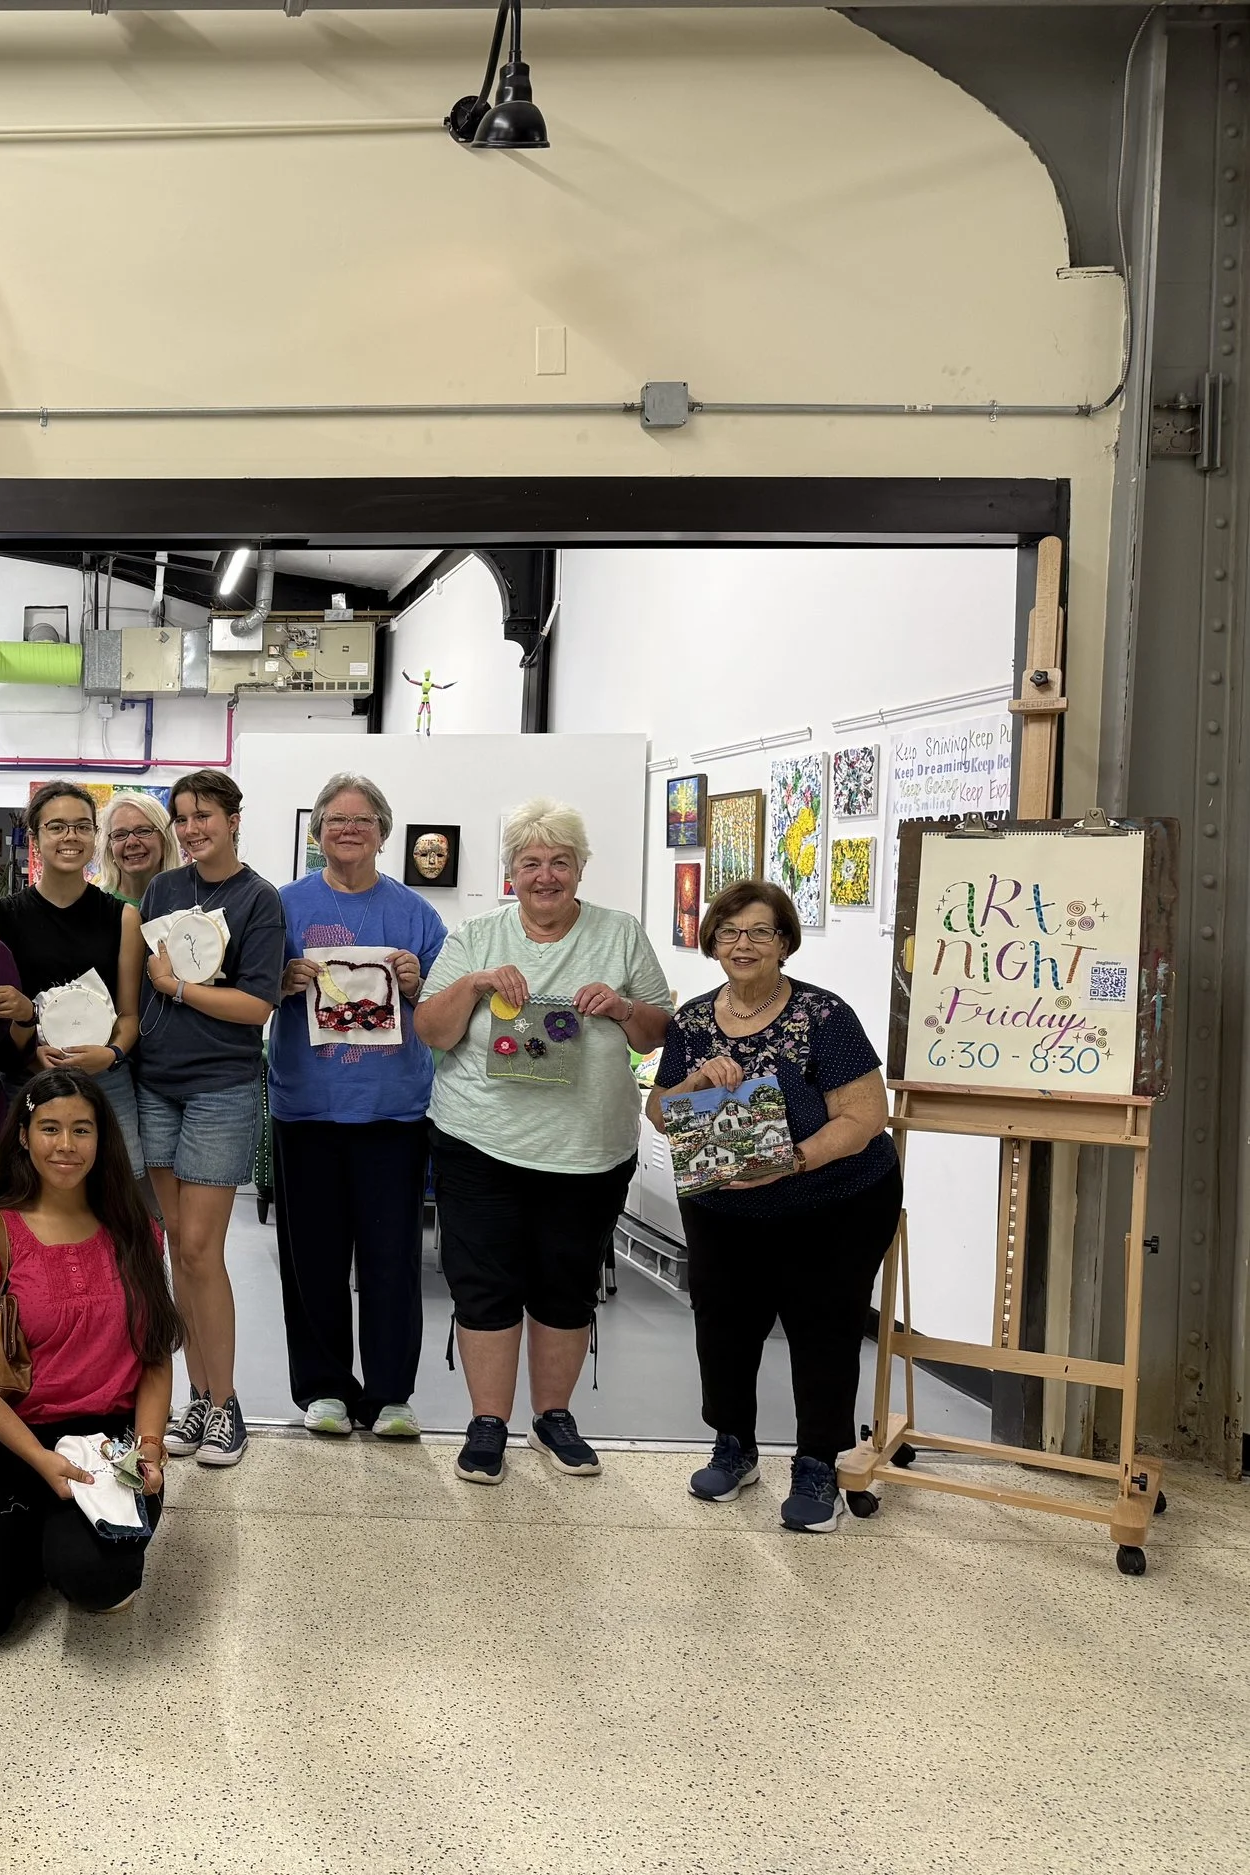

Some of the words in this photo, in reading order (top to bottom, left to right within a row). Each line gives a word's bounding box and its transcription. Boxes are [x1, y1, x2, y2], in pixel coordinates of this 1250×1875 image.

[969, 729, 993, 750] Keep
[894, 766, 914, 780] Keep
[917, 759, 970, 777] Dreaming
[971, 757, 995, 774] Keep
[924, 775, 960, 800] Going
[960, 782, 983, 808] Keep
[892, 801, 913, 816] Keep
[914, 797, 951, 813] Smiling
[940, 987, 1097, 1050] Fridays
[928, 1039, 999, 1069] 6:30
[1030, 1043, 1100, 1074] 8:30
